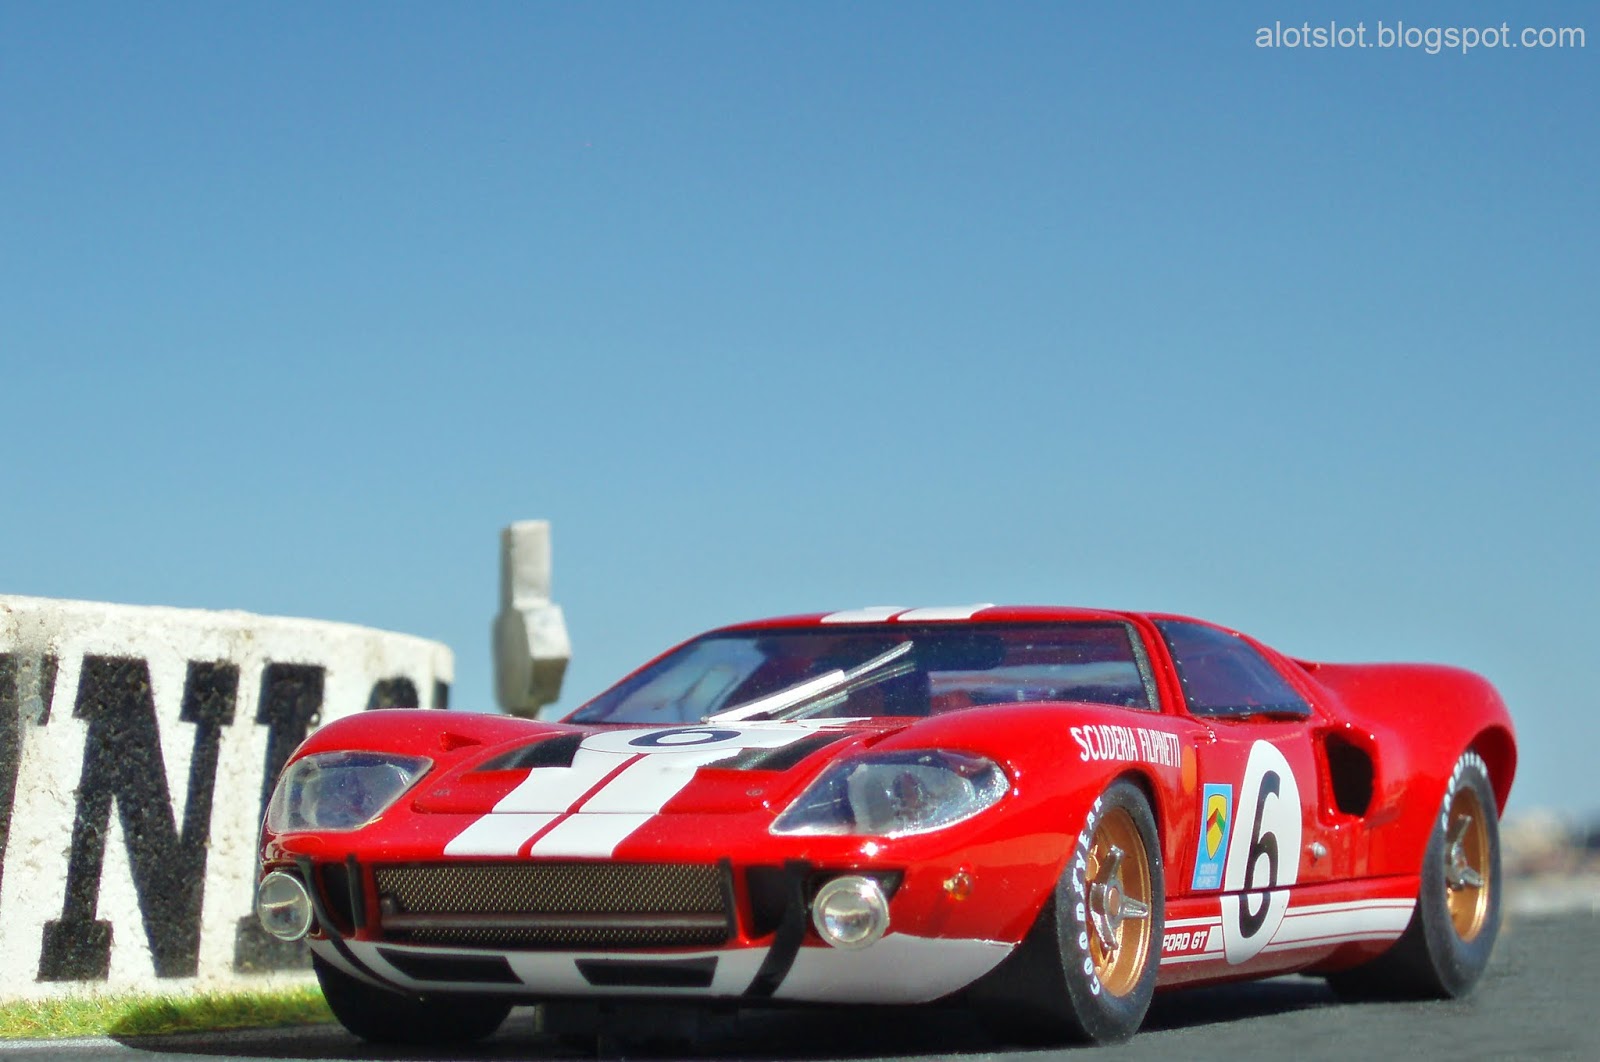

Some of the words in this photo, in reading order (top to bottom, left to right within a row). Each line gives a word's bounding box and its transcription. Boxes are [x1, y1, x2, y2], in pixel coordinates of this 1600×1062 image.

[1070, 725, 1139, 762] SCUDERIA
[1239, 770, 1281, 939] 6
[1162, 932, 1190, 951] FORD
[1190, 930, 1208, 949] GT
